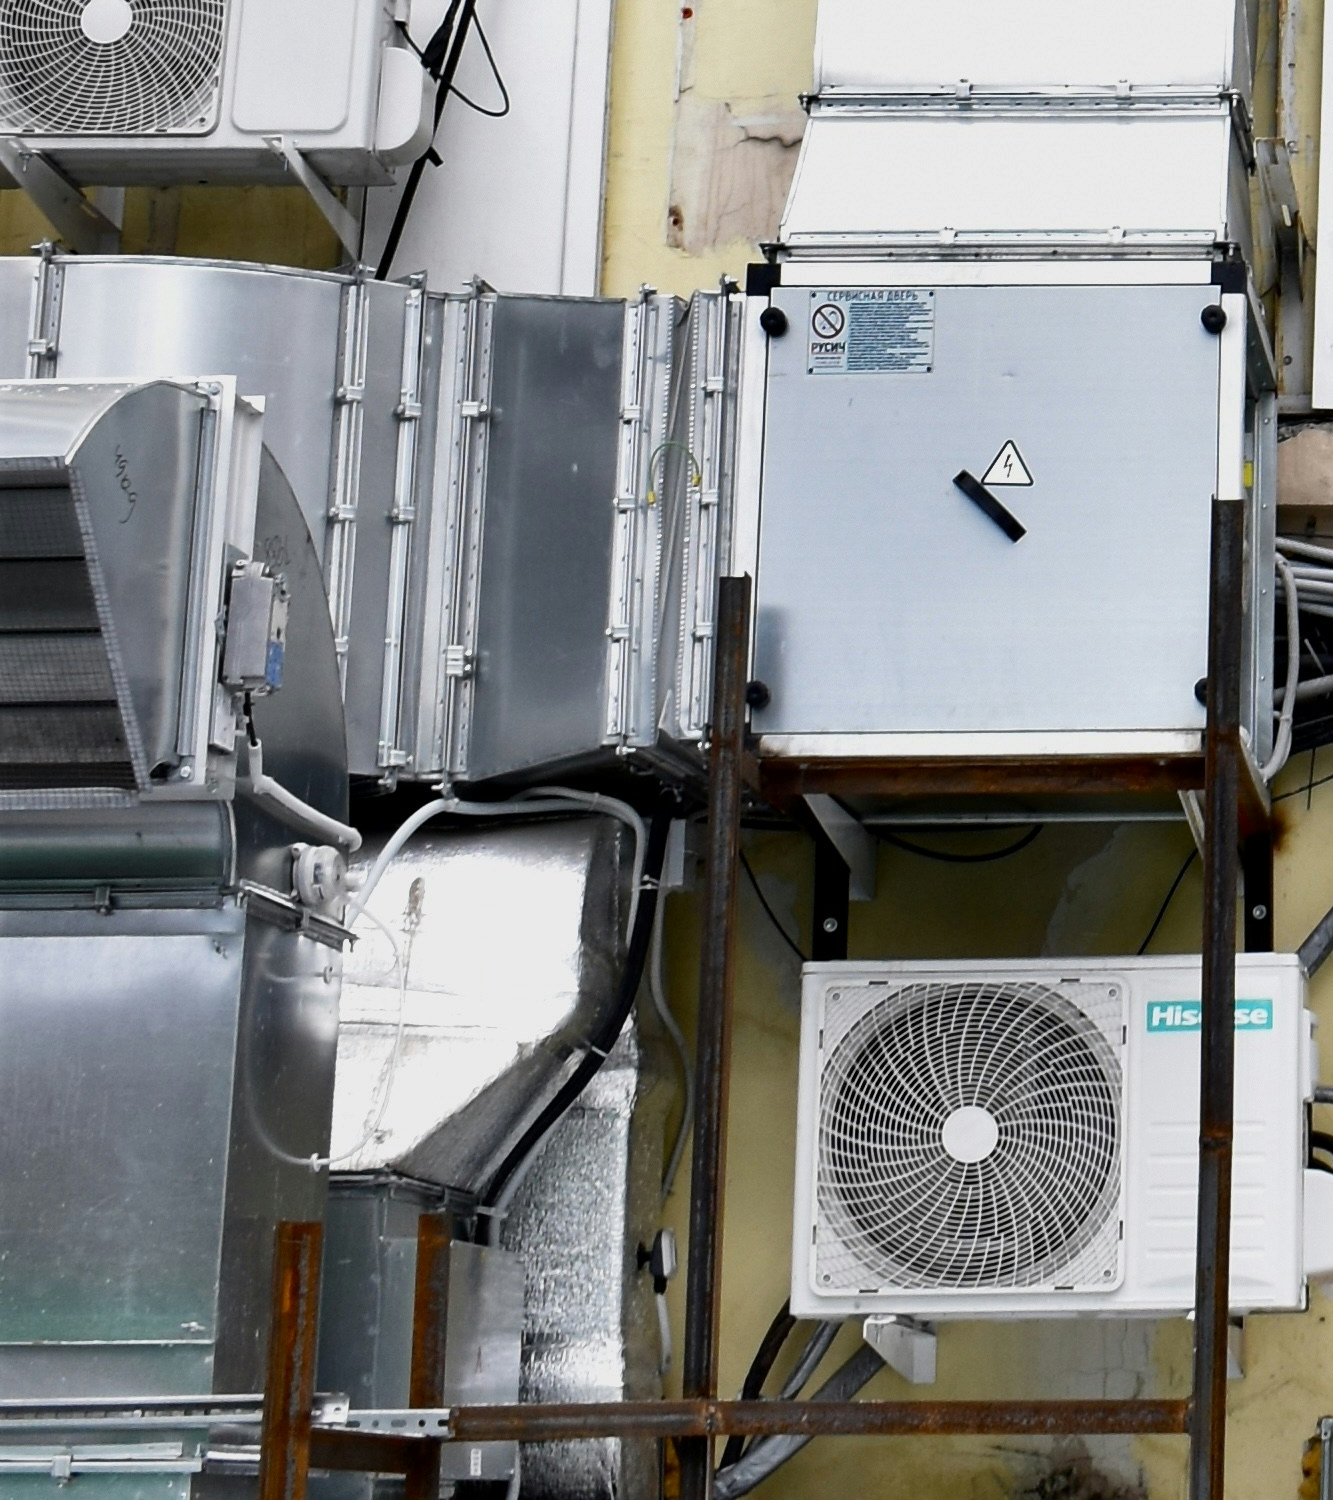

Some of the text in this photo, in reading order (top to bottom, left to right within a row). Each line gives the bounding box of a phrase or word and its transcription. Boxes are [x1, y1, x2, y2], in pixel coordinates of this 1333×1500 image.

[827, 290, 919, 302] СЕРВИСНАЯ ДВЕРЬ
[811, 341, 846, 354] РУСИЧ
[1152, 1005, 1268, 1027] Hisse
